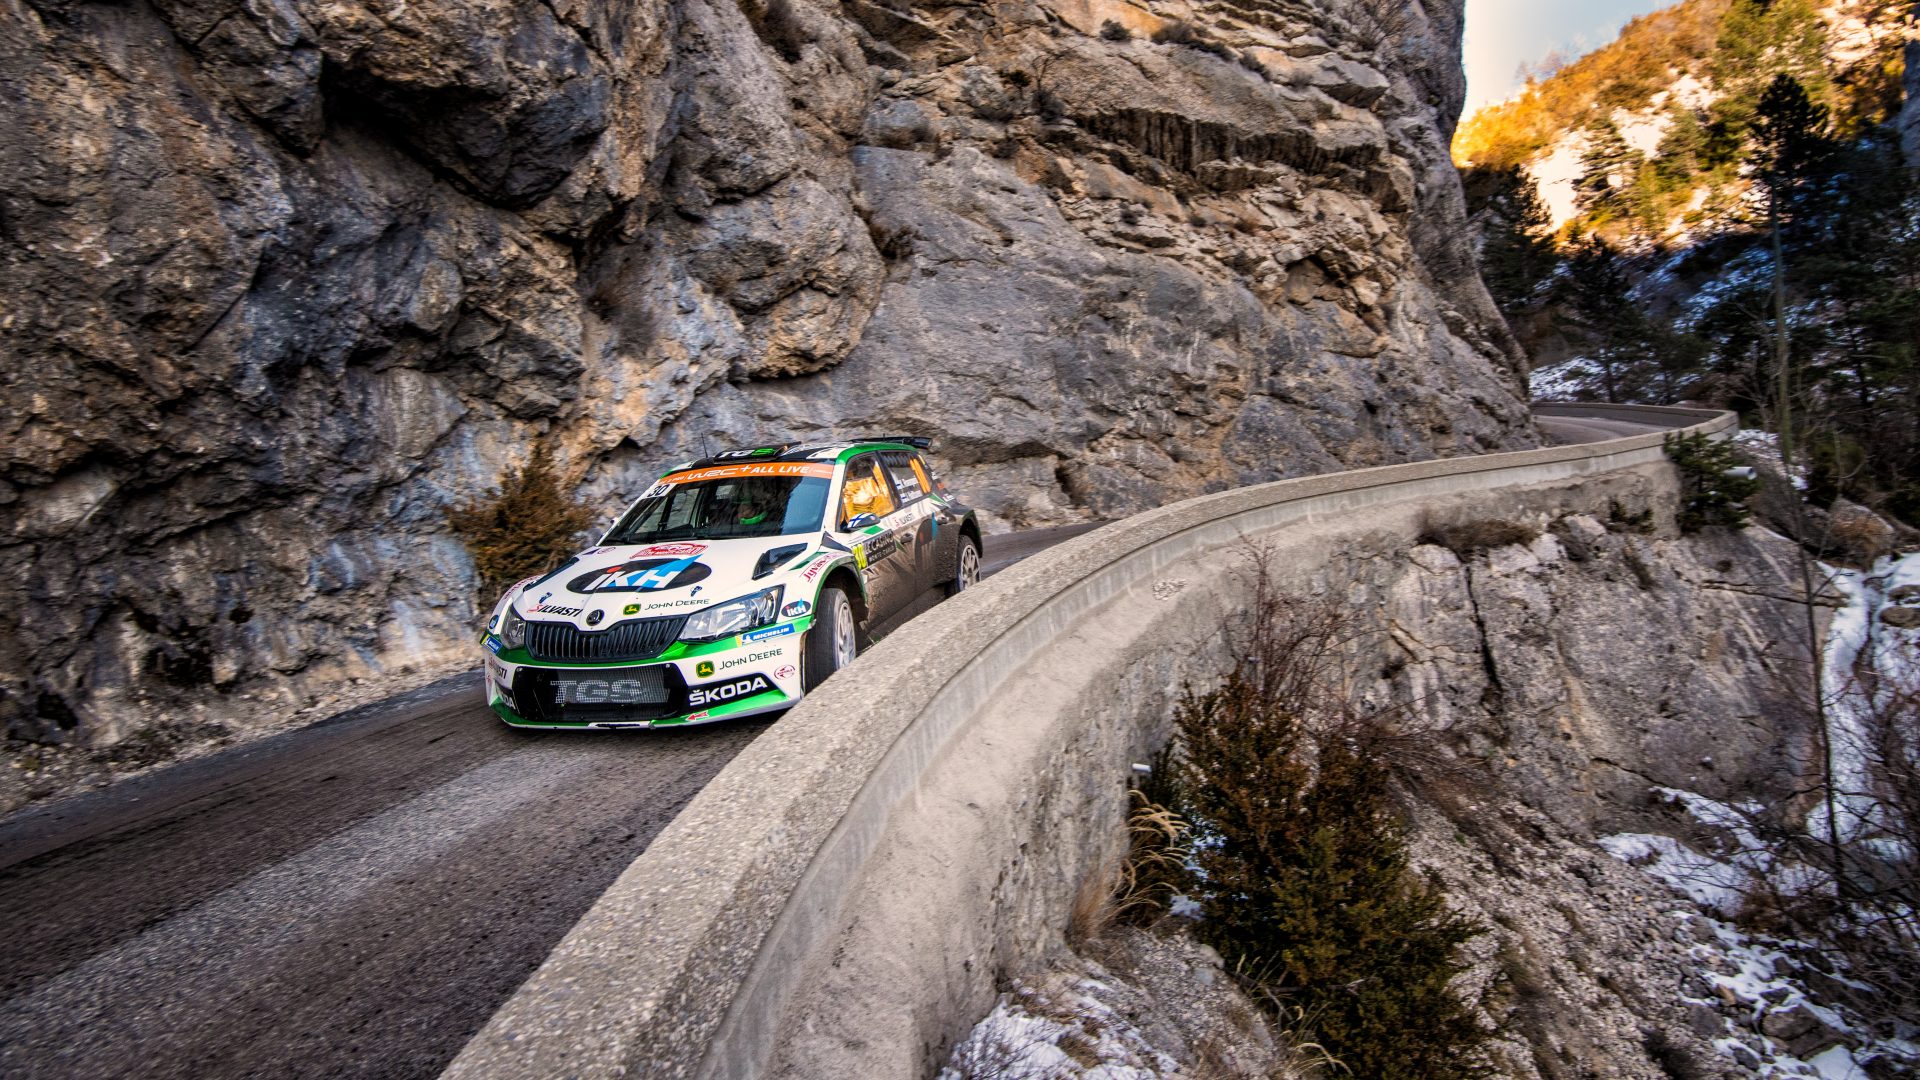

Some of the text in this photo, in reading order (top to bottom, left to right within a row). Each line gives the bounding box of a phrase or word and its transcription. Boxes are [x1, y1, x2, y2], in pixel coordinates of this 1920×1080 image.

[751, 463, 775, 474] ALL
[778, 464, 811, 474] LIVE
[647, 484, 668, 498] 30
[526, 604, 584, 618] SILVASTI
[644, 599, 711, 611] JOHN DEERE
[752, 627, 790, 641] MICHELIN
[719, 648, 783, 671] JOHN DEERE
[550, 679, 643, 703] TGS
[688, 677, 768, 707] ŠKODA
